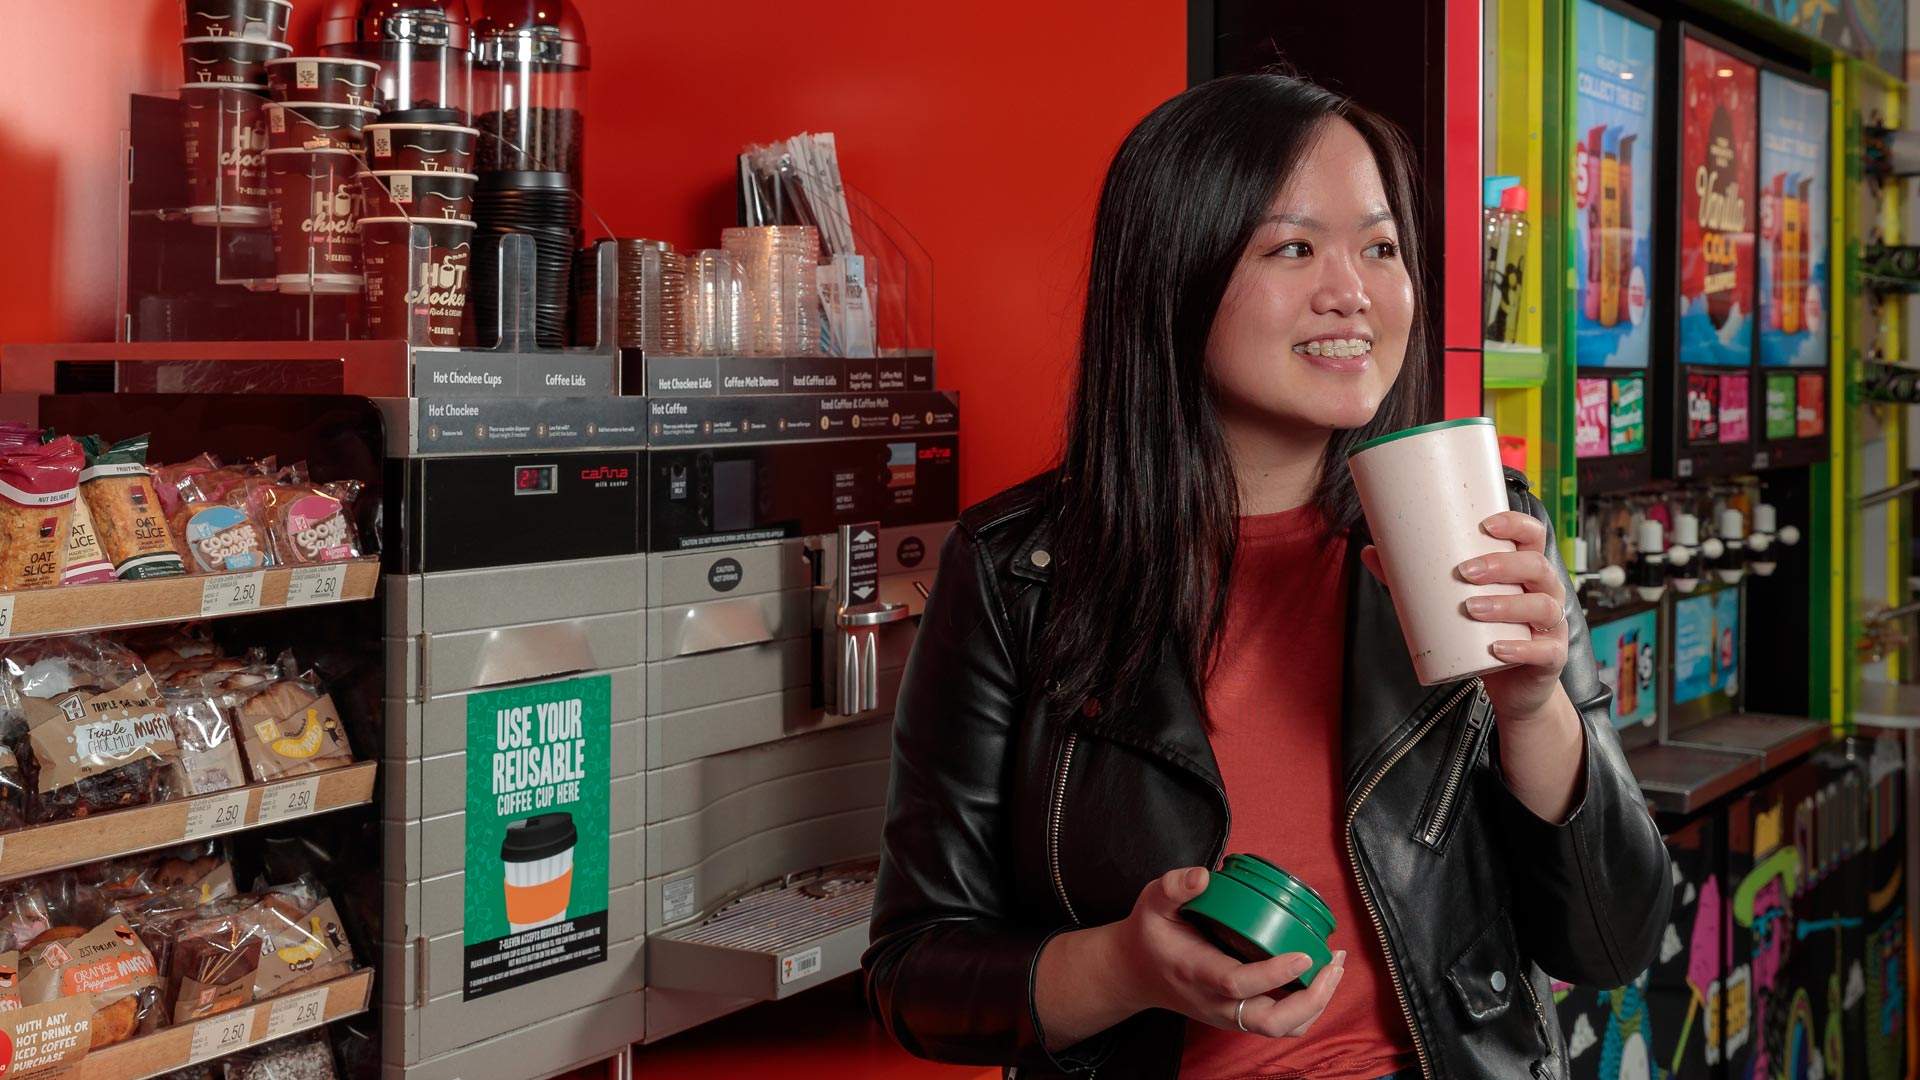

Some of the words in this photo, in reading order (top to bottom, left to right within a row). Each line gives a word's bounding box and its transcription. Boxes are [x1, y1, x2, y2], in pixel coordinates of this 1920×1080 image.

[433, 371, 448, 383] Hot
[449, 371, 482, 384] Chockee
[483, 372, 502, 388] Cups
[545, 374, 570, 386] Coffee
[571, 374, 586, 386] Lids
[658, 378, 671, 389] Hot
[671, 378, 698, 389] Chockee
[699, 377, 712, 388] Lids
[724, 377, 744, 388] Coffee
[745, 376, 758, 387] Melt
[759, 376, 779, 387] Domes
[793, 375, 805, 386] Iced
[806, 375, 825, 386] Coffee
[825, 375, 837, 385] Lids
[429, 404, 444, 416] Hot
[445, 404, 480, 416] Chockee
[652, 403, 664, 414] Hot
[665, 403, 687, 414] Coffee
[821, 400, 833, 410] Iced
[834, 400, 852, 409] Coffee
[858, 399, 876, 408] Coffee
[877, 398, 889, 407] Melt
[581, 466, 628, 479] cafina
[50, 493, 70, 502] DELIGHT
[72, 524, 86, 537] AT
[136, 517, 157, 528] OAT
[135, 528, 166, 539] SLICE
[201, 525, 257, 551] COOKIE
[30, 551, 55, 563] OAT
[23, 563, 56, 576] SLICE
[233, 584, 255, 601] 2.50
[315, 577, 336, 593] 2.50
[91, 700, 118, 712] TRIPLE
[86, 722, 126, 740] Triple
[497, 706, 532, 751] USE
[537, 699, 582, 744] YOUR
[88, 738, 112, 755] CHOC
[112, 732, 136, 751] MUD
[492, 739, 585, 795] REUSABLE
[288, 790, 310, 808] 2.50
[498, 789, 532, 816] COFFEE
[535, 786, 554, 808] CUP
[557, 781, 580, 805] HERE
[216, 804, 239, 823] 2.50
[500, 936, 520, 951] 7-ELEVEN
[521, 931, 540, 945] ACCEPTS
[297, 1002, 318, 1021] 2.50
[16, 1018, 42, 1034] WITH
[46, 1012, 68, 1027] ANY
[16, 1033, 38, 1047] HOT
[41, 1024, 72, 1042] DRINK
[74, 1020, 89, 1031] OR
[222, 1023, 244, 1043] 2.50
[14, 1046, 37, 1061] ICED
[41, 1036, 78, 1054] COFFEE
[13, 1051, 65, 1073] PURCHASE
